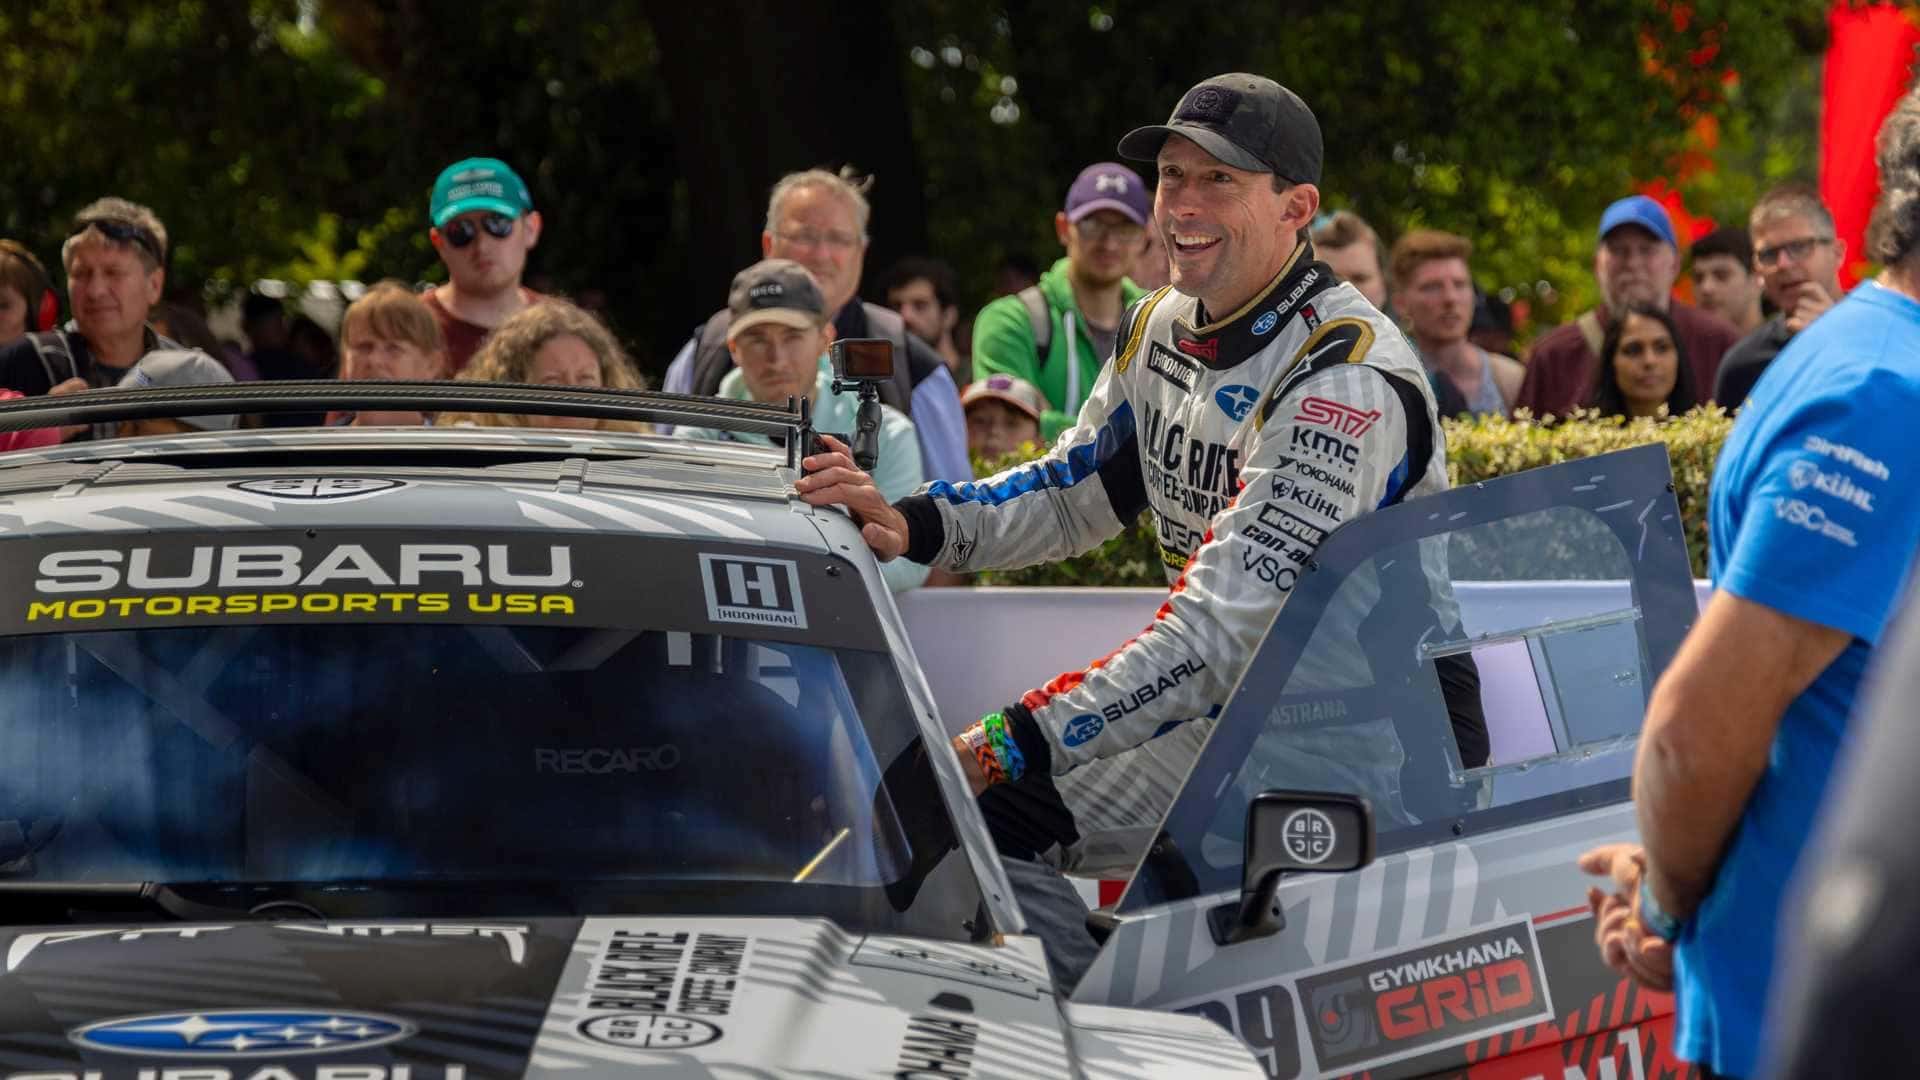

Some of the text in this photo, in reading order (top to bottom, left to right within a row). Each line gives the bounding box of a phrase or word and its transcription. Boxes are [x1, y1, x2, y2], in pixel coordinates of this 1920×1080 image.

[1276, 267, 1319, 314] SUBARU
[1296, 461, 1356, 498] YOKOHAMA
[1290, 485, 1342, 522] KÜHL
[1261, 508, 1323, 545] MOTUL
[27, 593, 575, 621] MOTORSPORTS USA
[1102, 656, 1207, 723] SUBARU
[1264, 699, 1348, 727] ASTRANA
[535, 743, 681, 775] RECARO
[587, 930, 690, 1012] BLACK RIFLE
[676, 932, 749, 1016] COFFEE COMPANY
[1368, 937, 1524, 993] GYMKHANA
